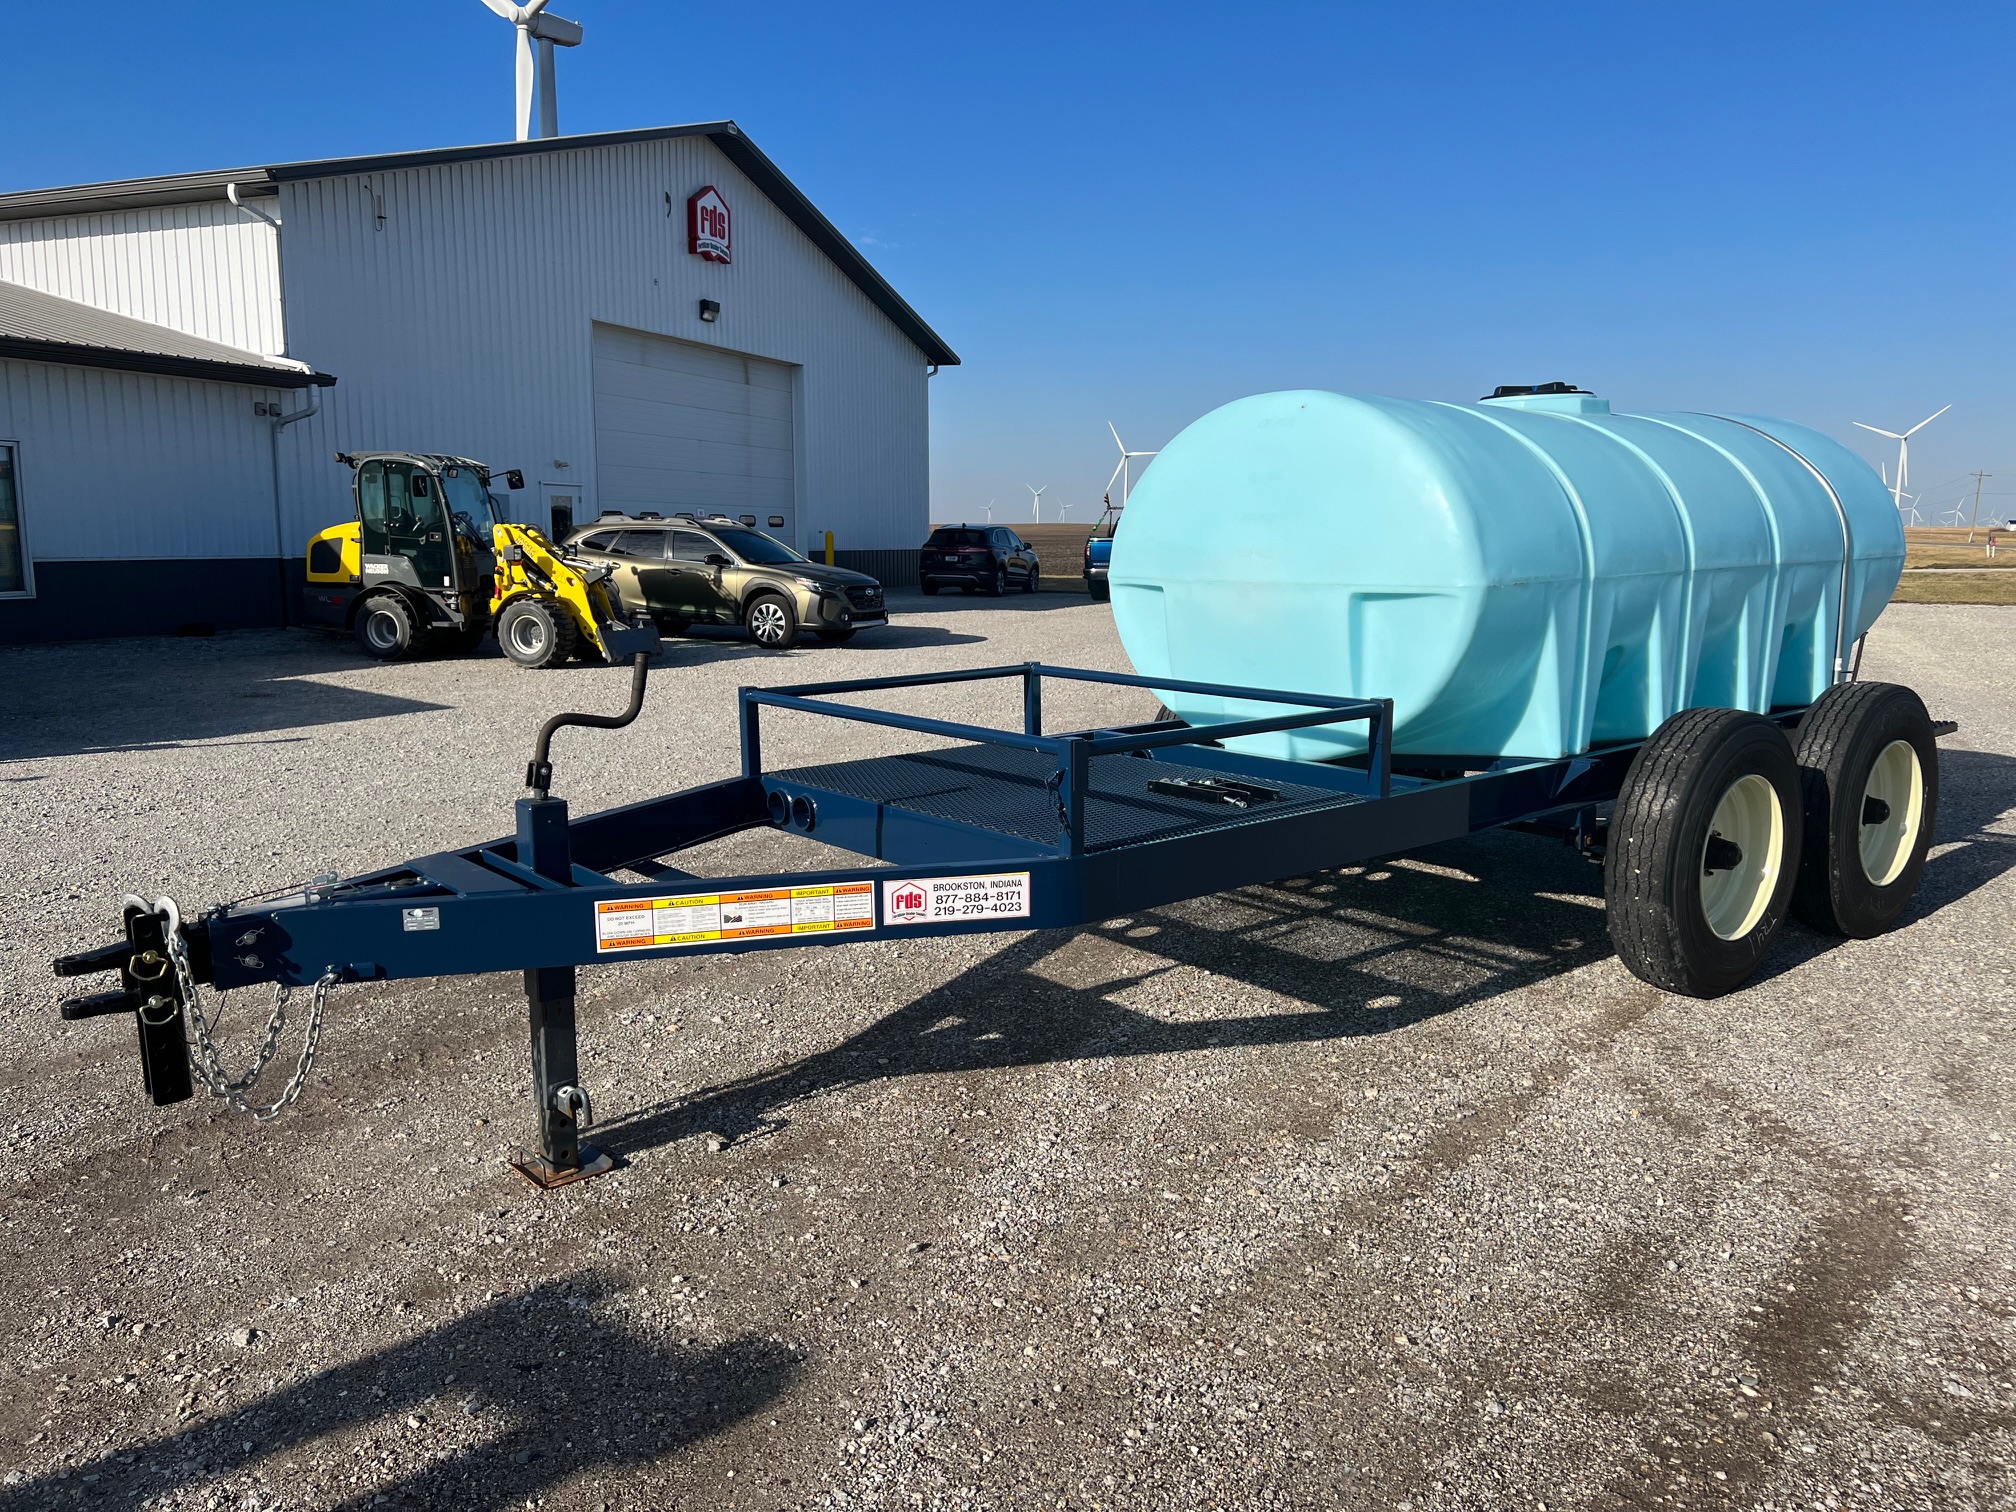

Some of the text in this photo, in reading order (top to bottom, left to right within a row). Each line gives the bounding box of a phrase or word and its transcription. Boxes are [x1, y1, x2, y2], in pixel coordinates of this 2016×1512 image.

[701, 205, 725, 240] fds
[933, 879, 1023, 892] BROOKSTON, INDIANA
[896, 892, 922, 909] fds
[935, 891, 1021, 904] 877-884-8171
[934, 902, 1022, 916] 219-279-4023
[797, 923, 831, 931] IMPORTANT
[844, 920, 871, 928] WARNING
